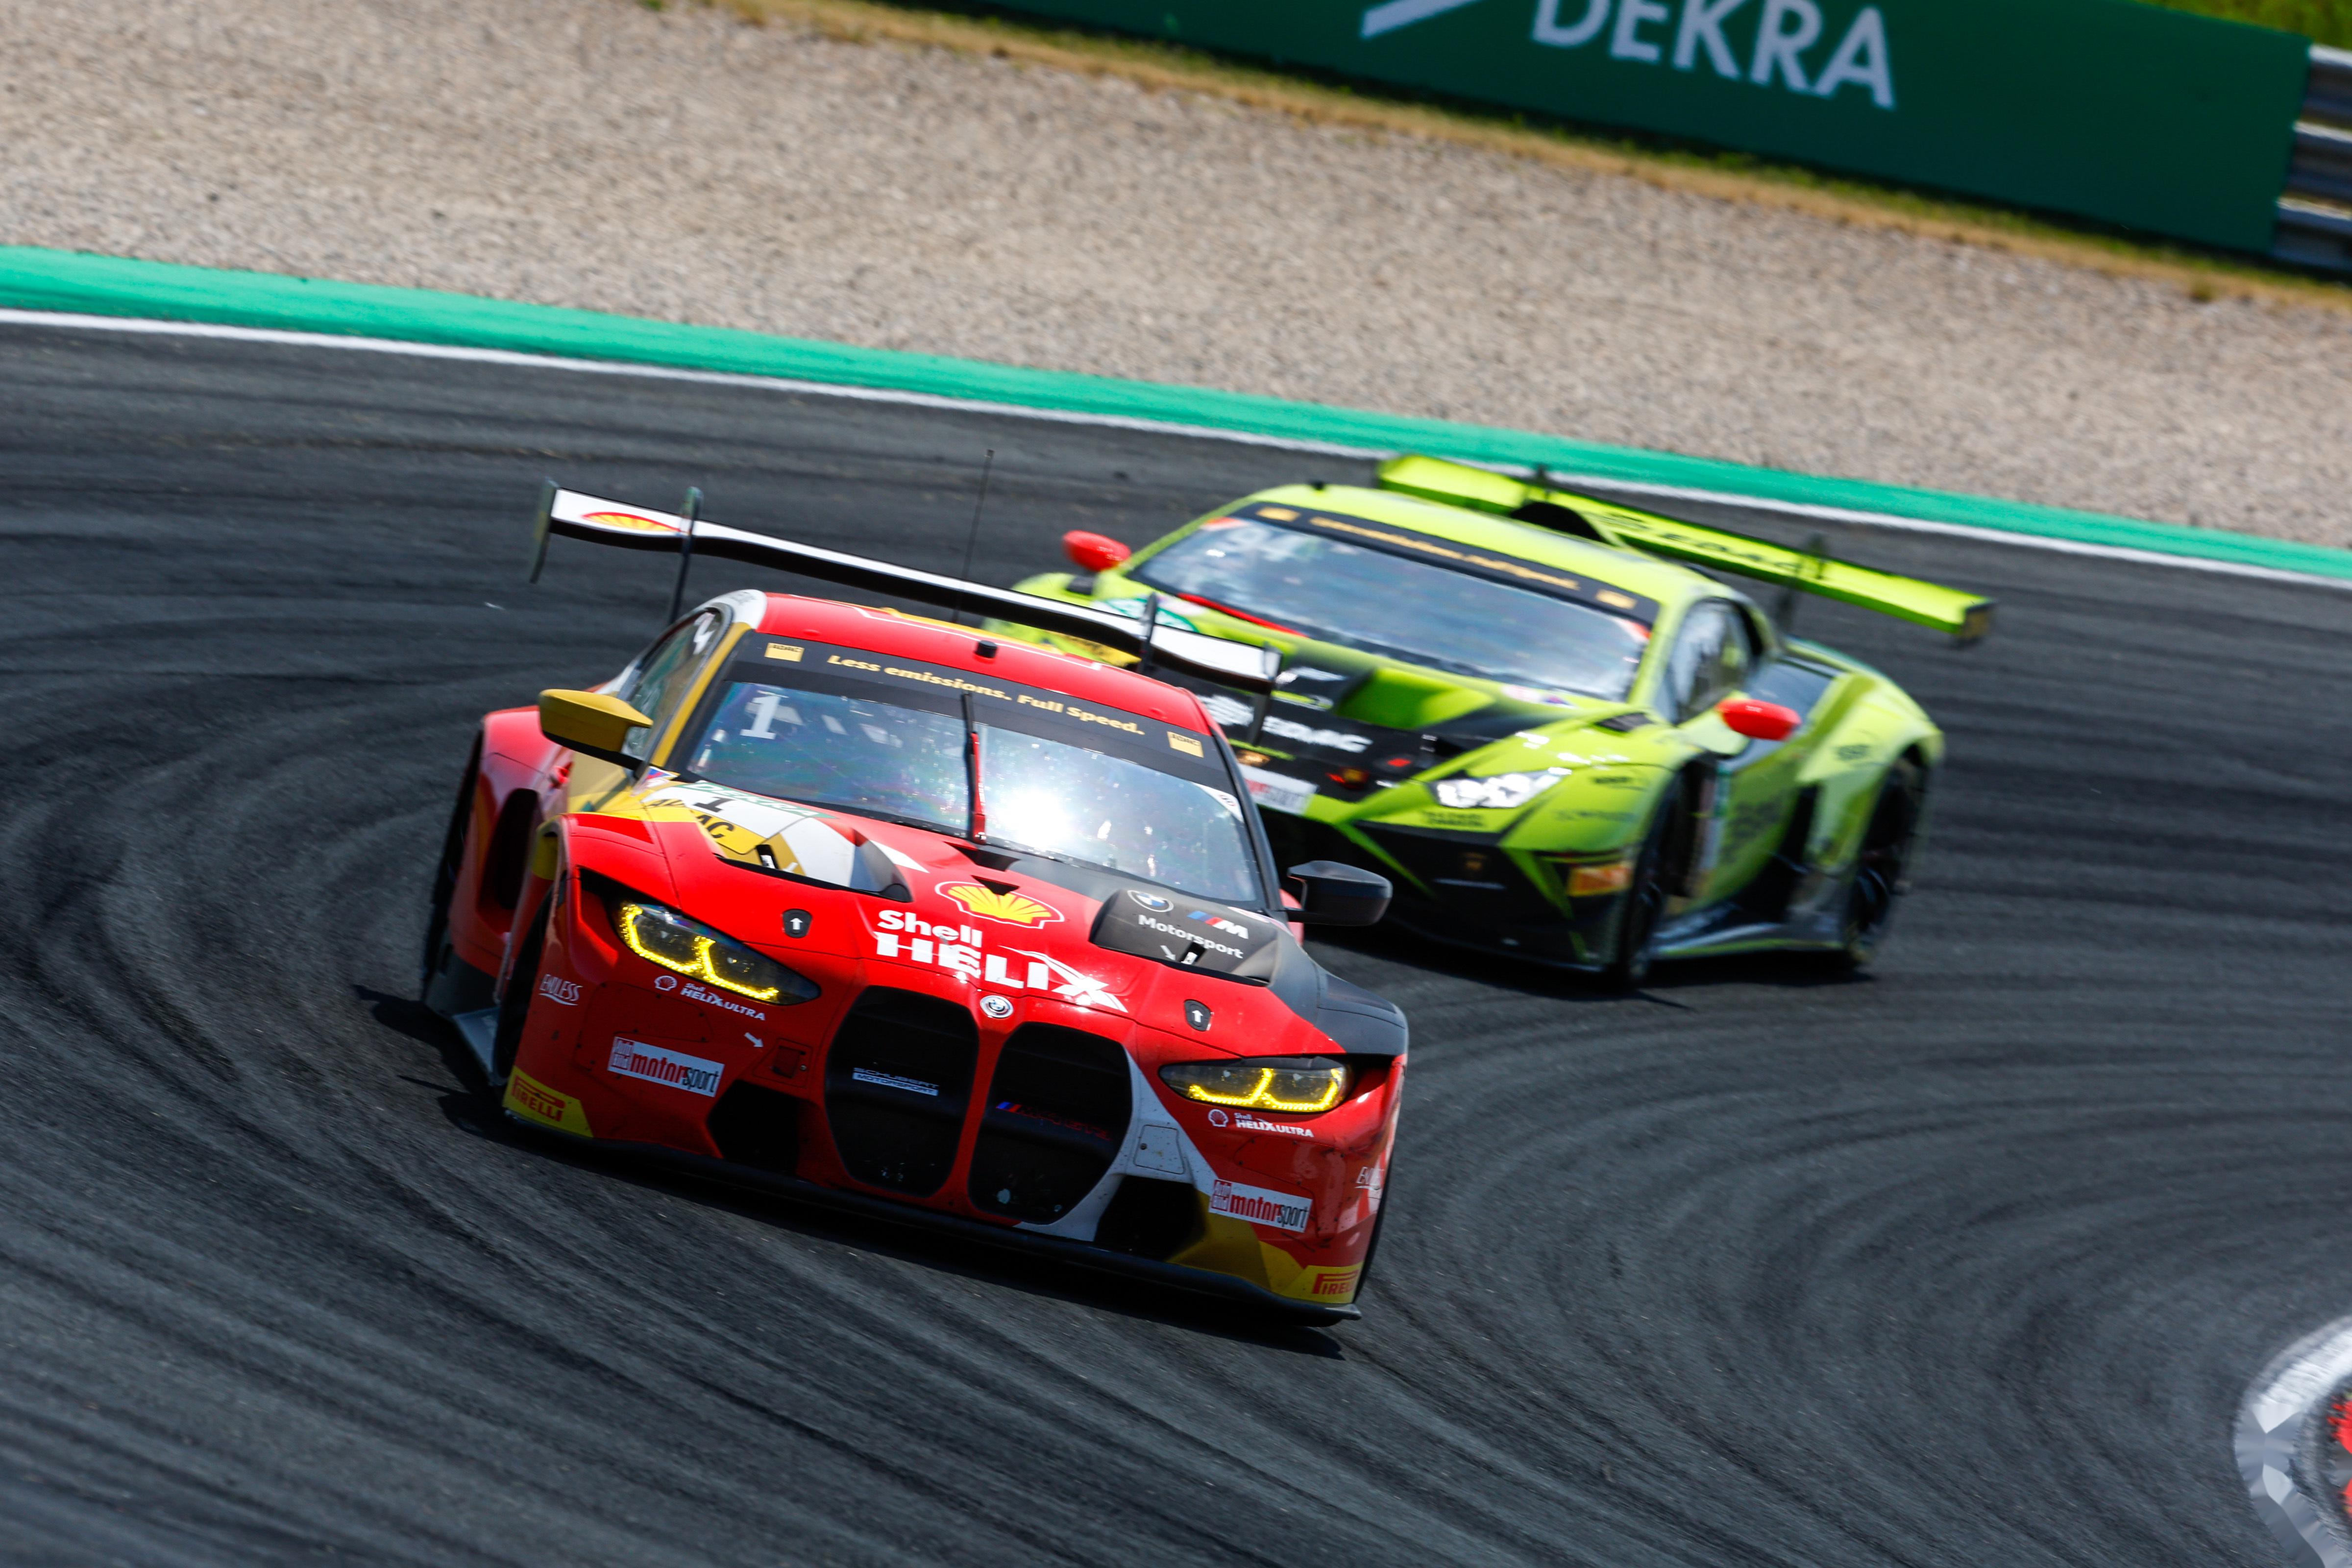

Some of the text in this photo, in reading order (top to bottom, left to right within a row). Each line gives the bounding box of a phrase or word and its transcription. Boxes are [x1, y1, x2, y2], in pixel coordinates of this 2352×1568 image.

[827, 655, 1146, 735] Less emissions. Full Speed.
[740, 695, 781, 740] 1
[682, 783, 821, 817] DEKRA
[693, 796, 737, 813] 1
[877, 909, 982, 948] Shell
[1137, 914, 1244, 959] Motorsport
[539, 973, 583, 1001] ENDLESS
[685, 982, 706, 992] Shell
[874, 931, 1128, 1013] HELIX
[854, 1067, 939, 1088] SCHUBERT
[857, 1073, 934, 1094] MOTORSPORT
[512, 1075, 566, 1122] PIRELLI
[1234, 1112, 1253, 1120] Shell
